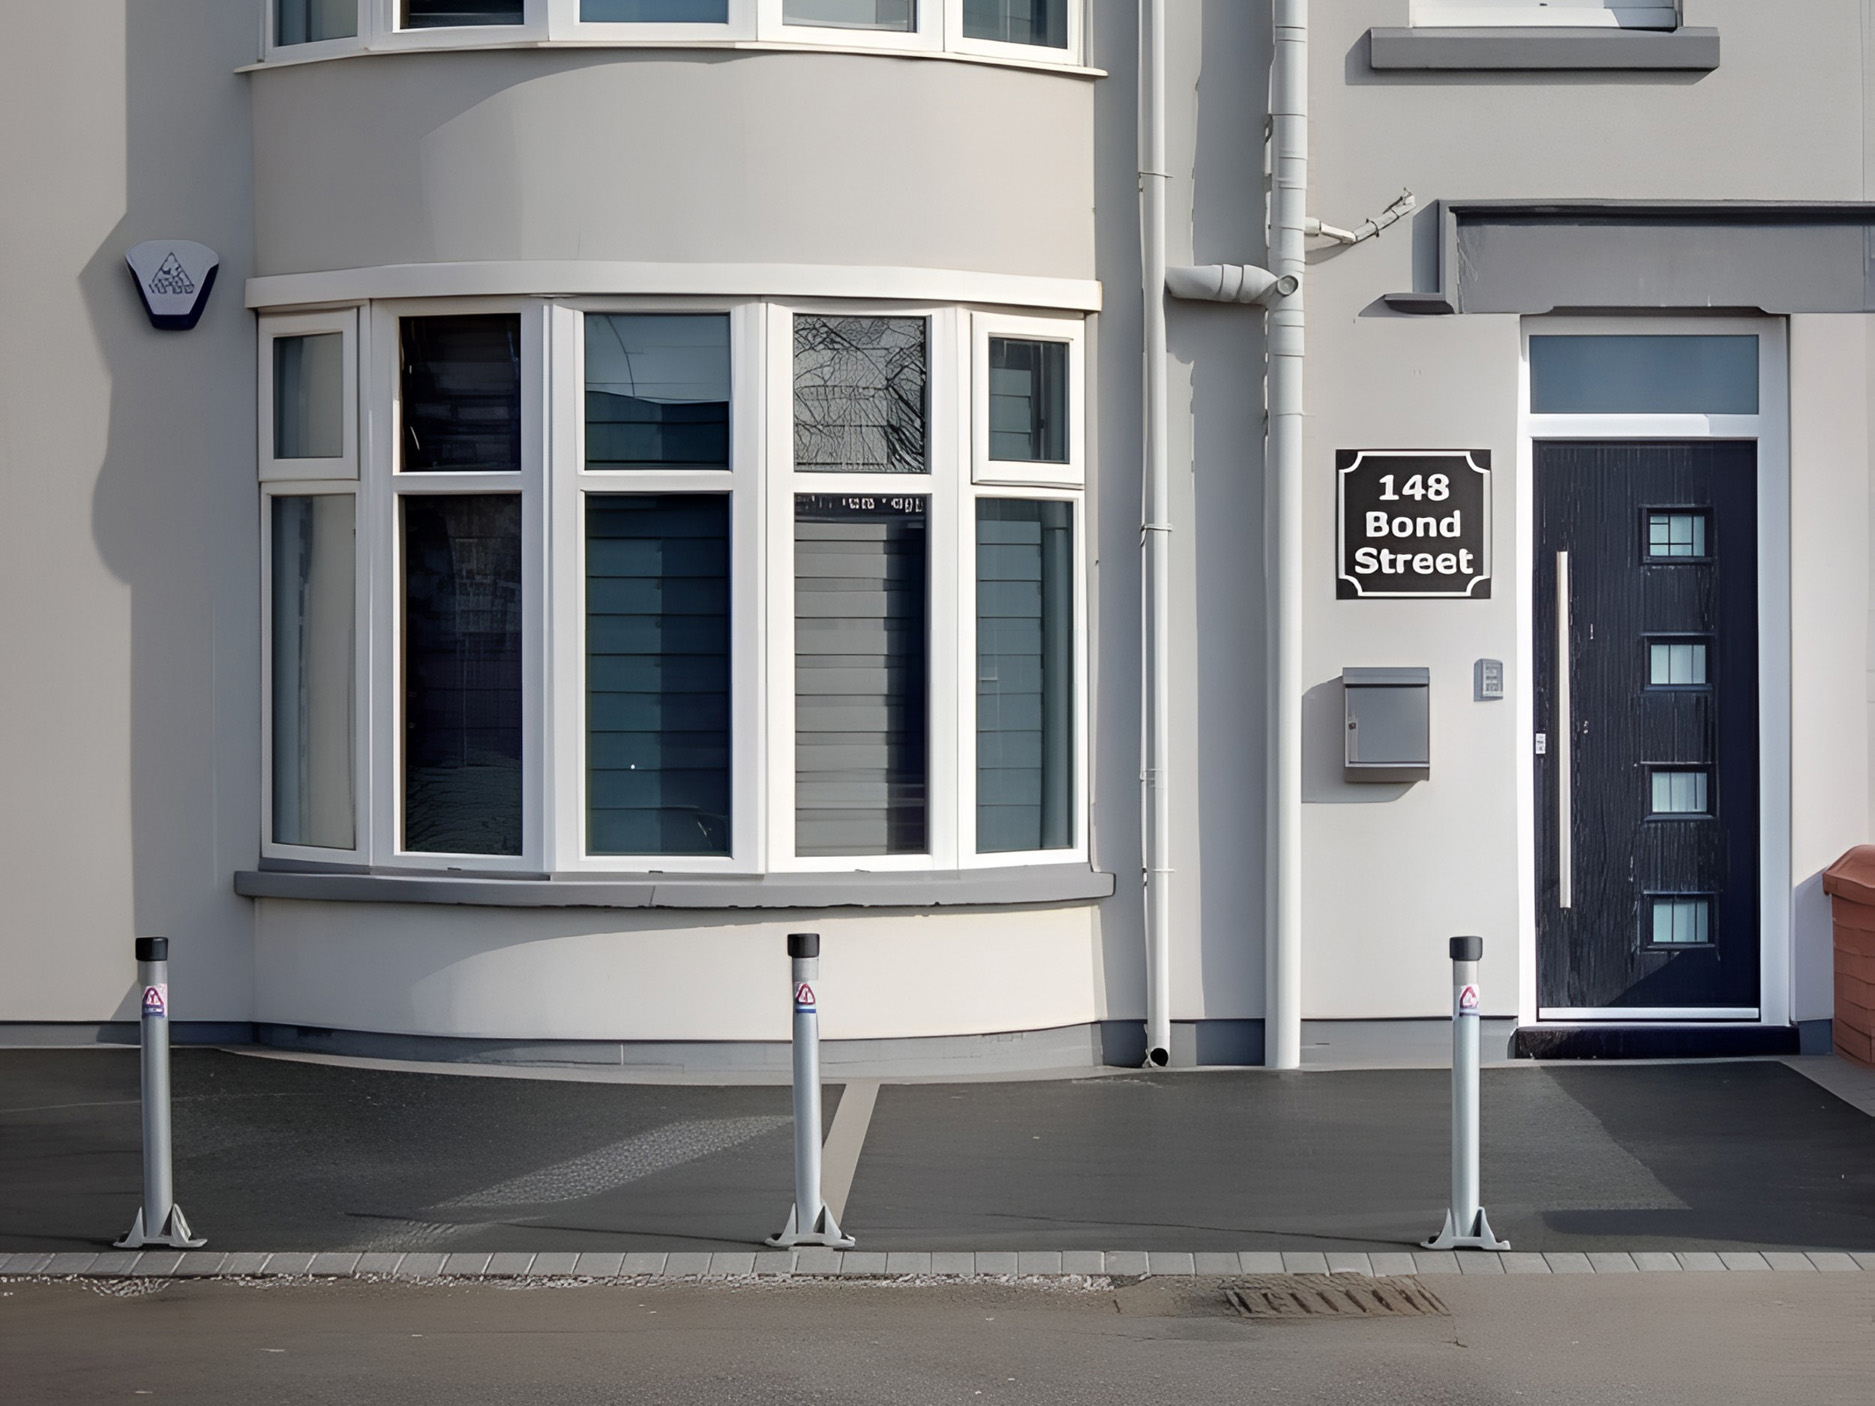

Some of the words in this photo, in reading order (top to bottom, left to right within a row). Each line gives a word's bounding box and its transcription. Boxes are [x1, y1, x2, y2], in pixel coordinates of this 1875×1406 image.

[1379, 473, 1450, 501] 148
[1365, 509, 1461, 538] Bond
[1354, 546, 1474, 575] Street
